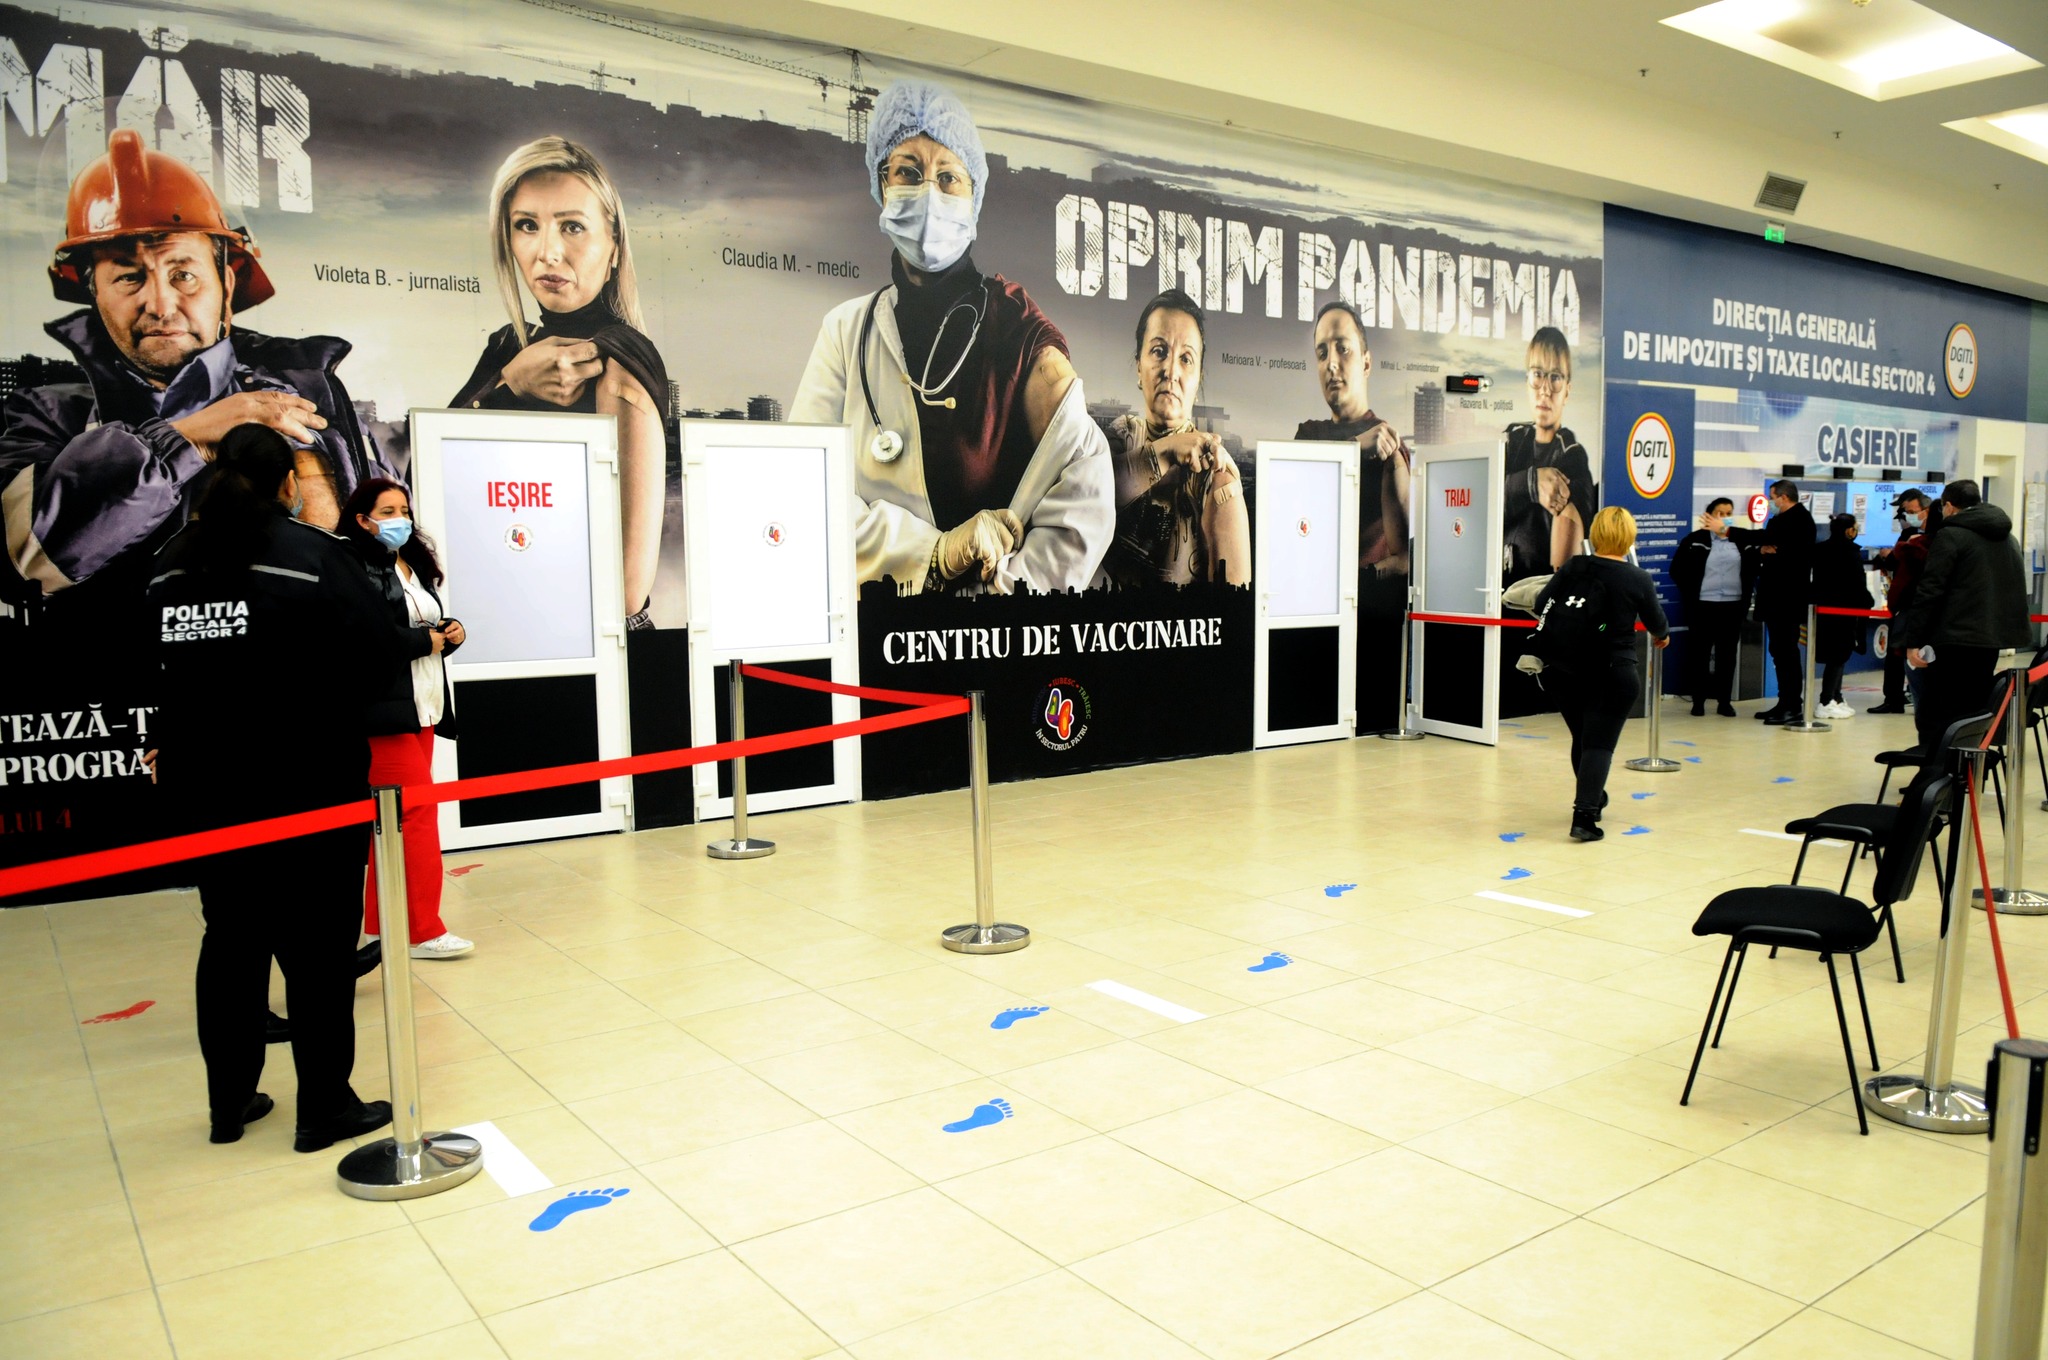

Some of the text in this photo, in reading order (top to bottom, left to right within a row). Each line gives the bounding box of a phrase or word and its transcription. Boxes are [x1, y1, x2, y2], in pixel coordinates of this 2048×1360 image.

[722, 247, 778, 270] Claudia
[783, 253, 801, 273] M.
[817, 260, 860, 279] medic
[1055, 194, 1580, 346] OPRIM PANDEMIA
[314, 263, 371, 285] Violeta
[375, 268, 391, 286] B.
[408, 272, 481, 293] jurnalistă
[1796, 312, 1877, 350] GENERALĂ
[1222, 353, 1255, 366] Marioara
[1255, 355, 1262, 367] V.
[1269, 357, 1307, 371] profesoară
[1623, 330, 1936, 396] DE IMPOZITE ȘI TAXE LOCALE SECTOR 4
[1949, 346, 1974, 364] DGITL
[1957, 368, 1964, 382] 4
[1633, 440, 1669, 458] DGITL
[1817, 424, 1918, 468] CASIERIE
[1647, 463, 1655, 480] 4
[487, 481, 553, 513] IEȘIRE
[1444, 488, 1471, 507] TRIAJ
[162, 600, 249, 623] POLITIA
[161, 617, 248, 633] LOCALA
[161, 626, 247, 642] SECTOR 4
[883, 618, 1222, 664] CENTRU DE VACCINARE
[1052, 677, 1076, 687] IUBESC
[1040, 736, 1071, 751] SECTORUL
[1070, 724, 1089, 746] PATRU
